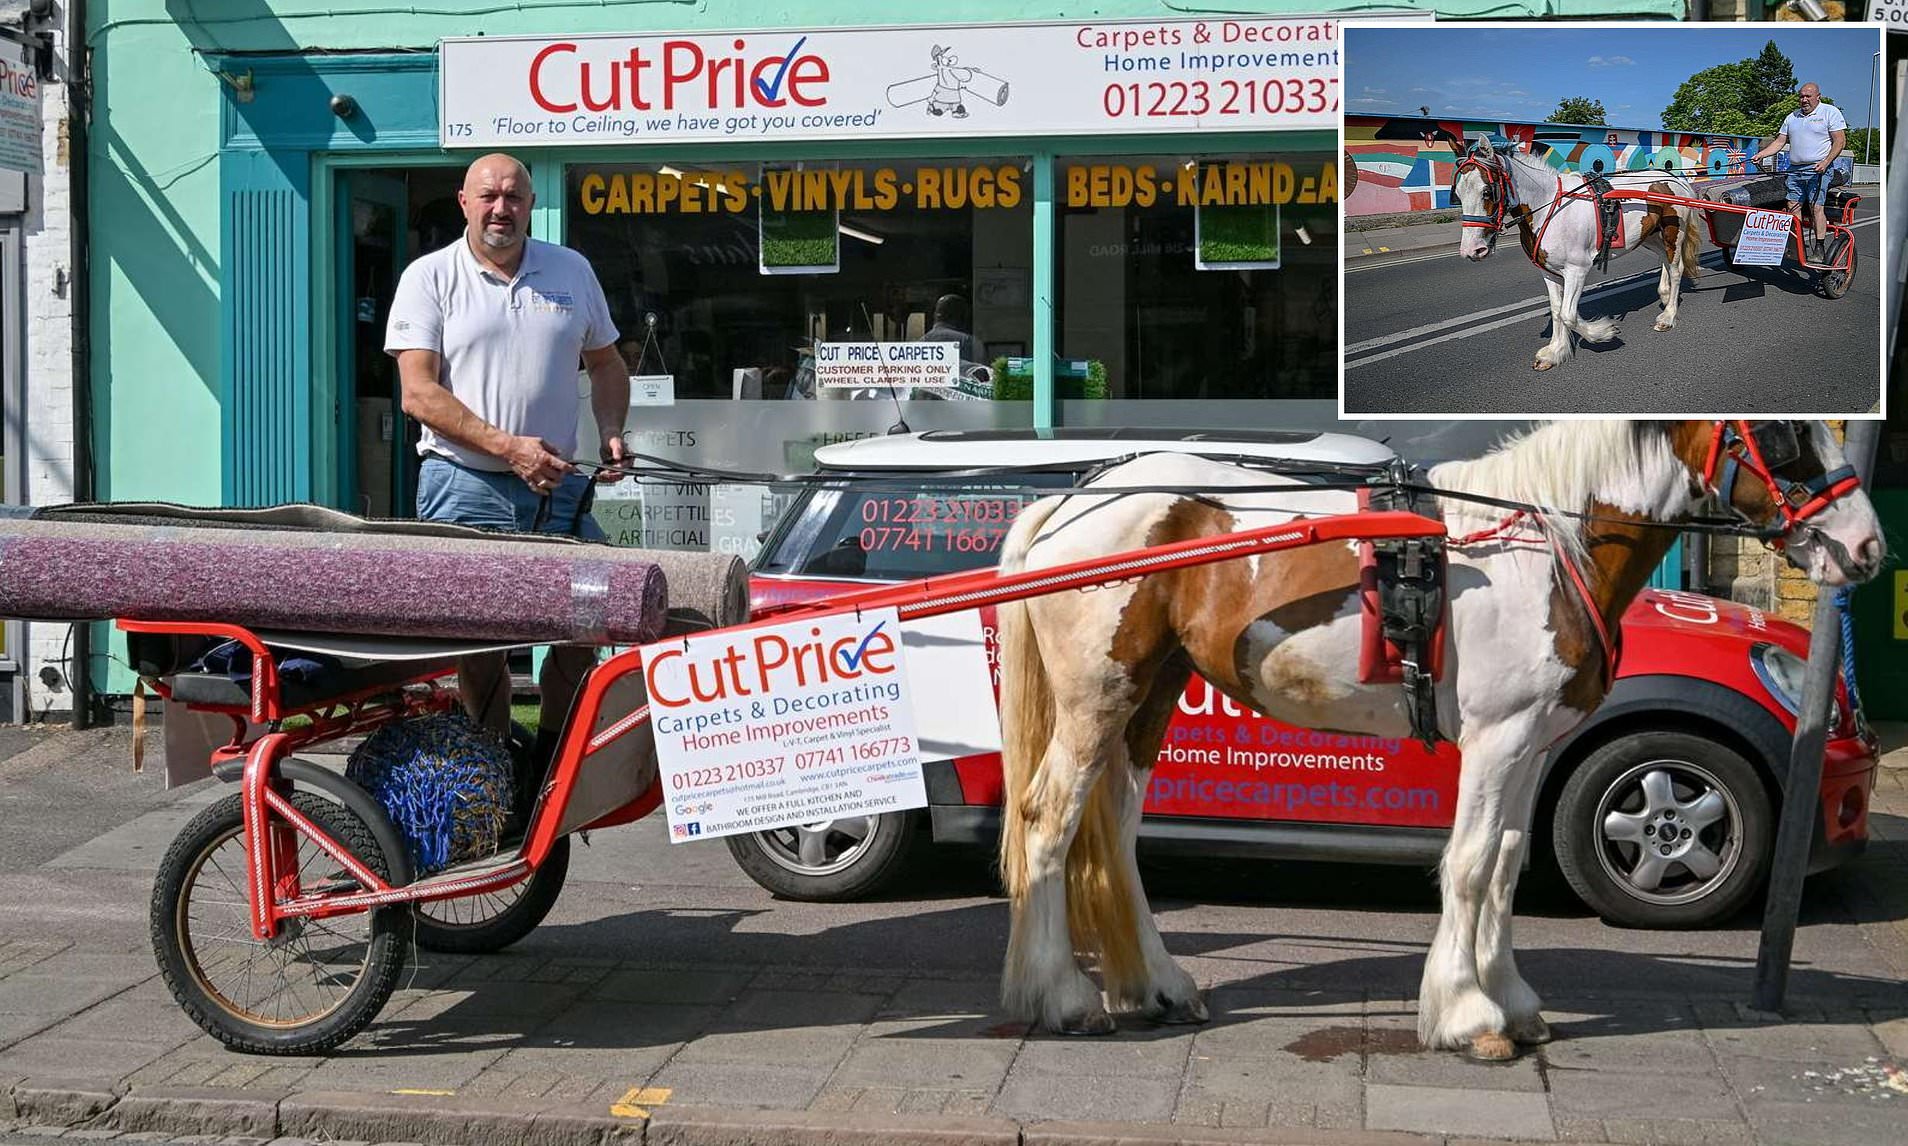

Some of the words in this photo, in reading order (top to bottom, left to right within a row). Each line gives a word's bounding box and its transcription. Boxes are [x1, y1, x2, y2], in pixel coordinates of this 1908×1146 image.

[1077, 26, 1182, 52] Carpets
[1193, 22, 1211, 44] &
[1104, 54, 1171, 72] Home
[1181, 49, 1338, 72] Improvement
[1103, 80, 1210, 118] 01223
[448, 123, 473, 137] 175
[549, 117, 566, 133] to
[572, 114, 639, 137] Ceiling,
[647, 119, 671, 131] we
[677, 113, 720, 131] have
[725, 115, 757, 135] got
[761, 117, 796, 134] you
[801, 109, 882, 129] covered'
[581, 170, 748, 215] CARPETS
[767, 168, 898, 212] VINYLS
[916, 165, 1021, 210] RUGS
[1067, 163, 1157, 208] BEDS
[820, 346, 840, 361] CUT
[848, 346, 879, 360] PRICE
[889, 346, 944, 360] CARPETS
[816, 365, 873, 375] CUSTOMER
[878, 365, 922, 374] PARKING
[926, 365, 952, 374] ONLY
[863, 376, 906, 384] CLAMPS
[910, 376, 920, 384] IN
[924, 376, 946, 384] USE
[618, 505, 684, 521] CARPET
[862, 499, 937, 523] 01223
[942, 499, 1032, 523] 21033
[618, 529, 709, 546] ARTIFICIAL
[860, 527, 933, 551] 07741
[657, 708, 742, 734] Carpets
[751, 701, 766, 719] &
[773, 682, 900, 715] Decorating
[683, 731, 741, 751] Home
[746, 705, 889, 742] Improvements
[804, 734, 828, 744] Carpet
[837, 728, 855, 738] Vinyl
[857, 724, 891, 736] Specialist
[672, 767, 723, 790] 01223
[725, 757, 785, 782] 210337
[795, 747, 844, 770] 07741
[851, 736, 911, 760] 166773
[1157, 744, 1221, 764] Home
[1227, 747, 1385, 771] Improvements
[736, 808, 749, 816] WE
[751, 803, 777, 812] OFFER
[779, 801, 785, 809] A
[786, 799, 805, 809] FULL
[807, 793, 842, 805] KITCHEN
[844, 789, 862, 799] AND
[1150, 774, 1439, 812] pricecarpets.com
[675, 801, 713, 816] Google
[706, 820, 753, 833] BATHROOM
[754, 814, 785, 826] DESIGN
[786, 811, 804, 820] AND
[805, 801, 863, 818] INSTALLATION
[864, 795, 897, 807] SERVICE
